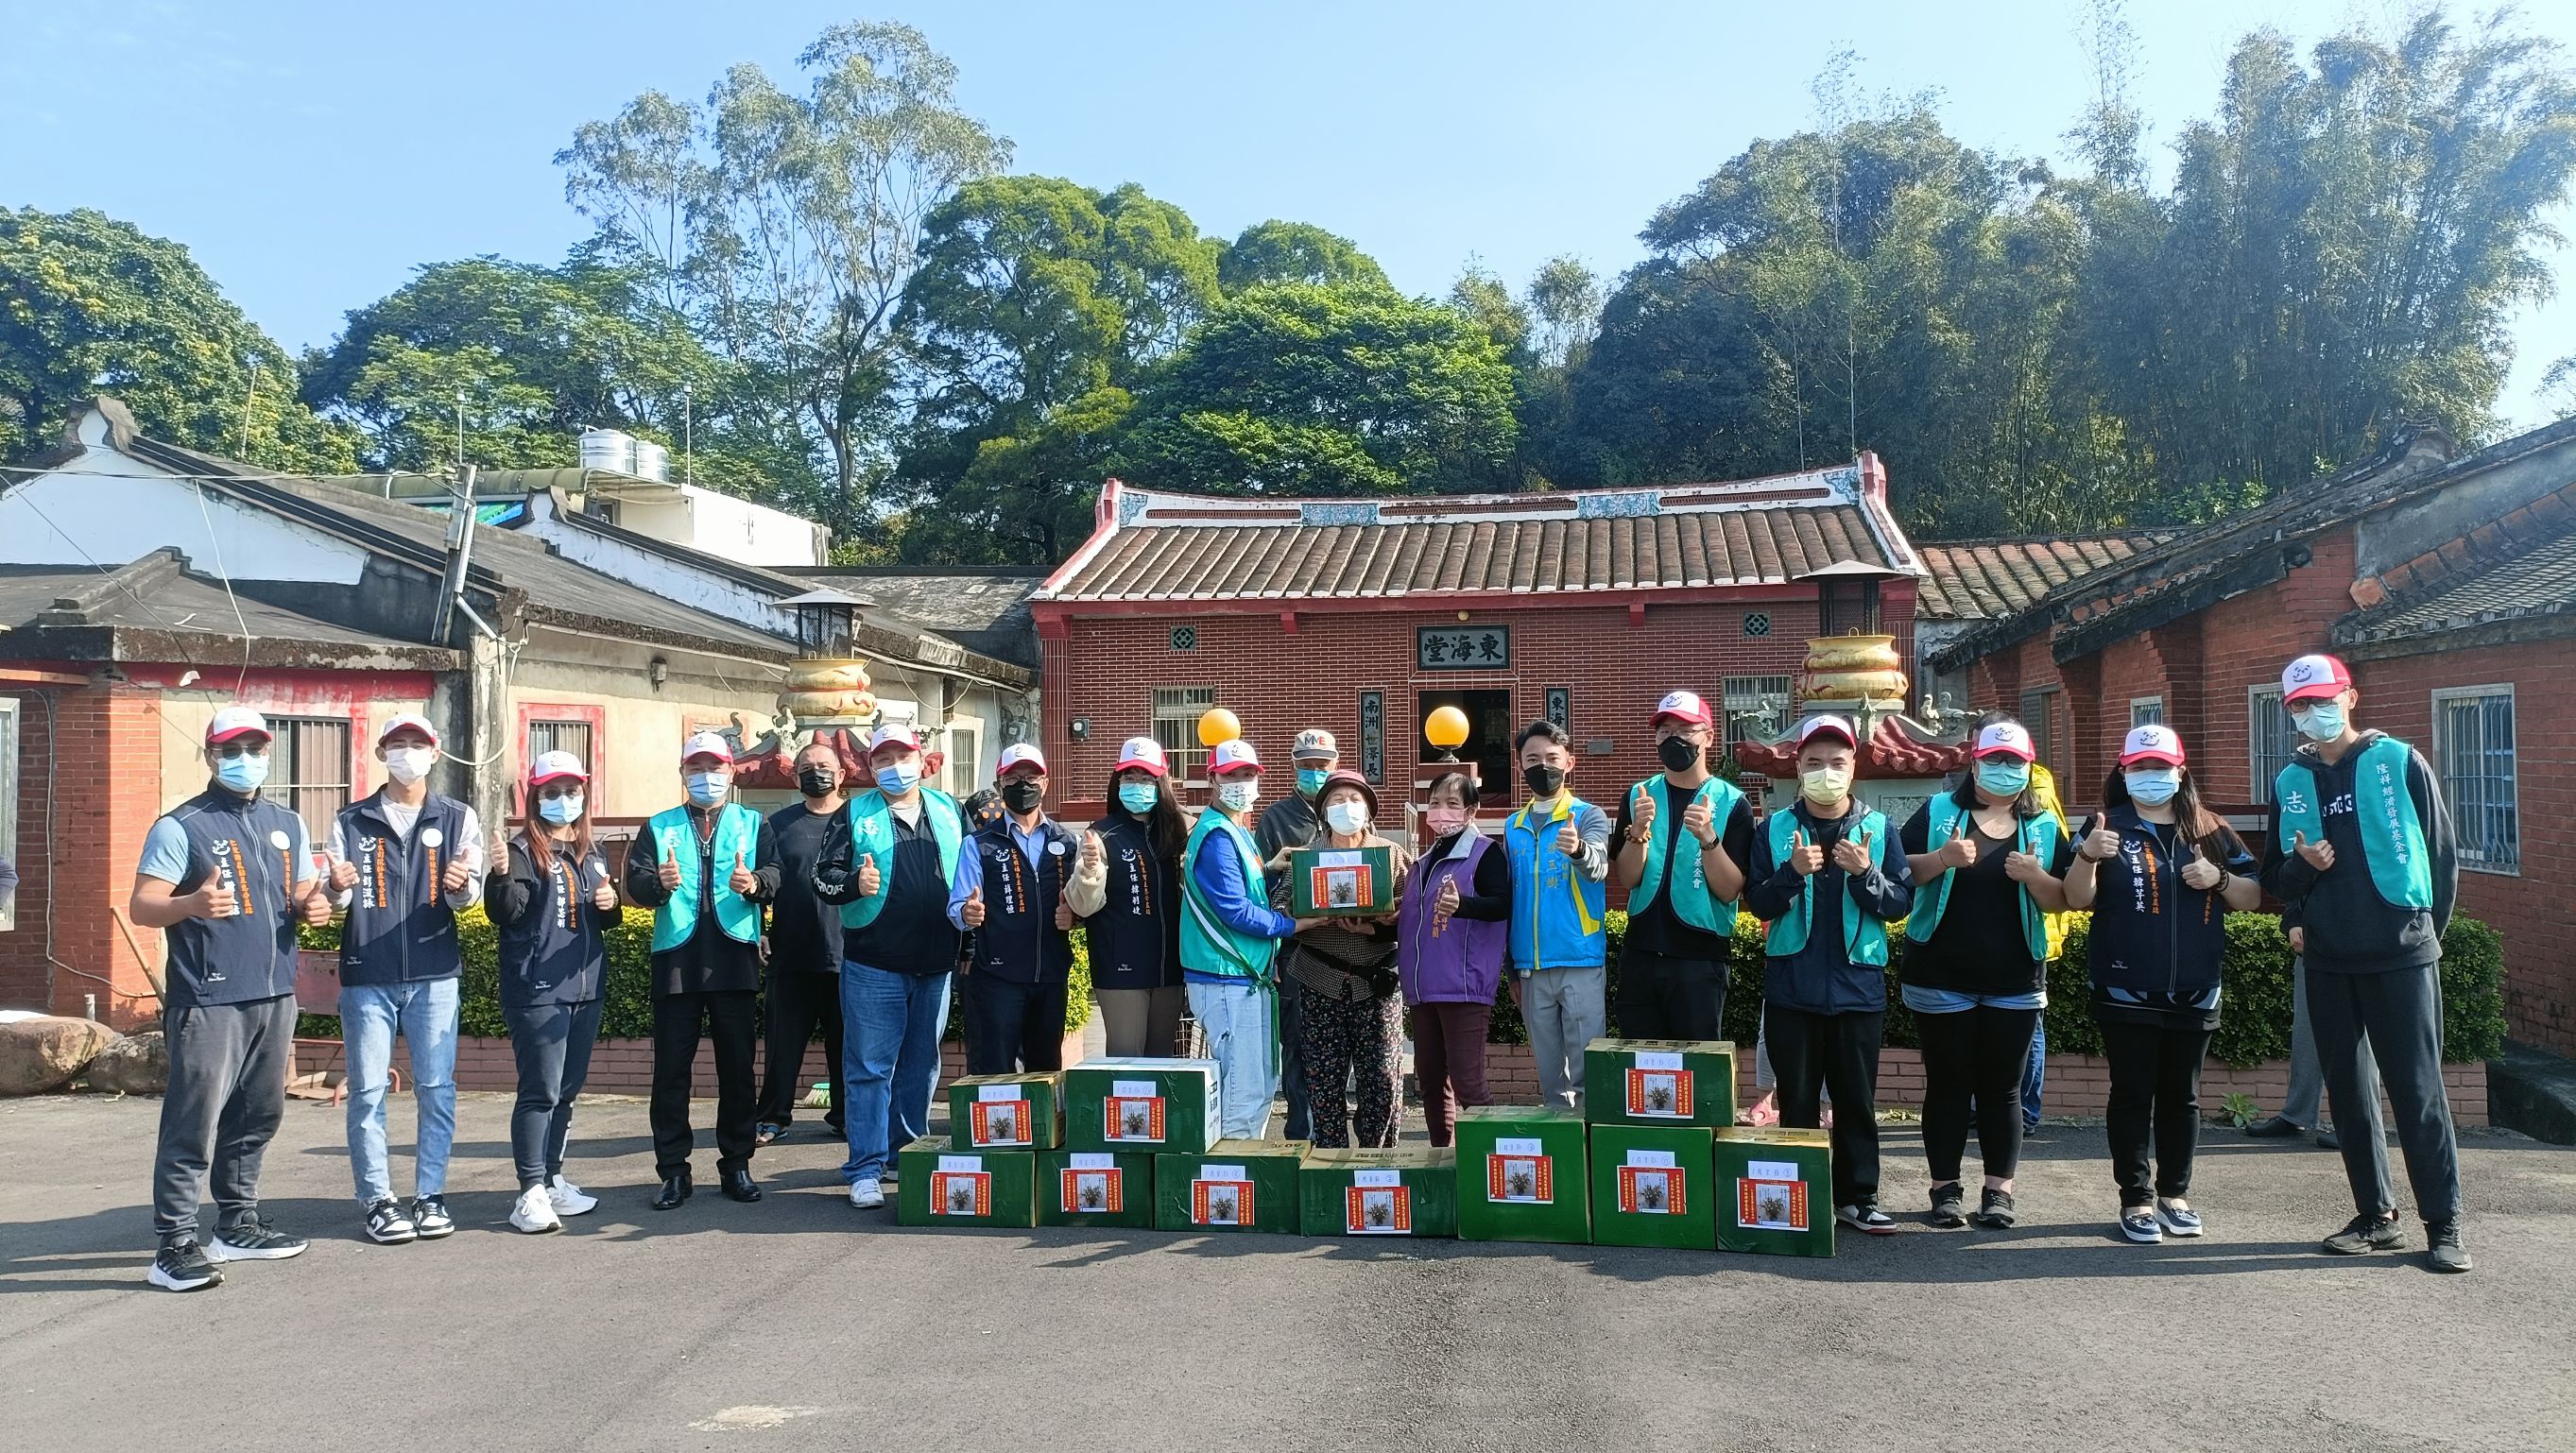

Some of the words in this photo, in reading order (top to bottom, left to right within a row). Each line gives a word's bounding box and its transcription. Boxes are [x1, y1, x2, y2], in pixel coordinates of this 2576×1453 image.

[2375, 762, 2409, 865] 隆祥經濟發展基金會
